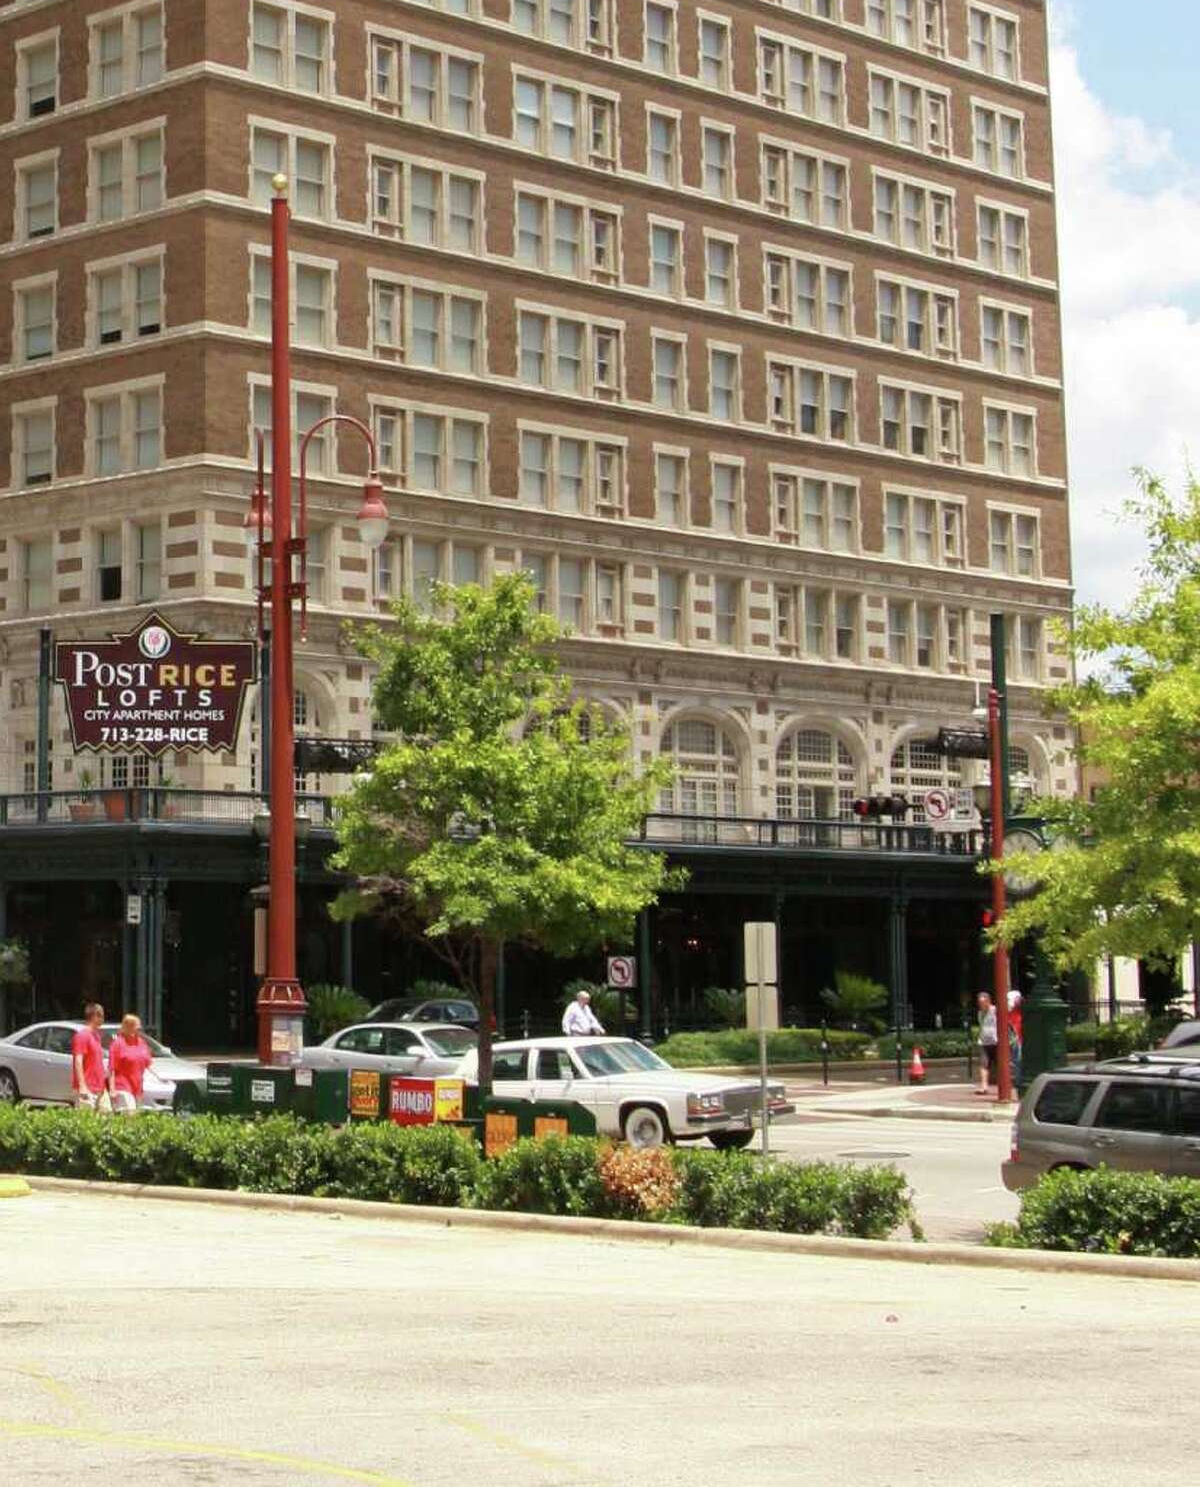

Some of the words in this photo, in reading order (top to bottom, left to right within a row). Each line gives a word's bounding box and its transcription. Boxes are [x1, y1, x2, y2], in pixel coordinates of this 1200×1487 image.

[158, 664, 236, 687] RICE
[97, 689, 212, 707] LOFTS
[84, 710, 110, 721] CITY
[112, 710, 181, 721] APARTMENT
[183, 710, 225, 721] HOMES
[101, 728, 208, 741] 713-228-RICE
[392, 1090, 433, 1114] RUMBO
